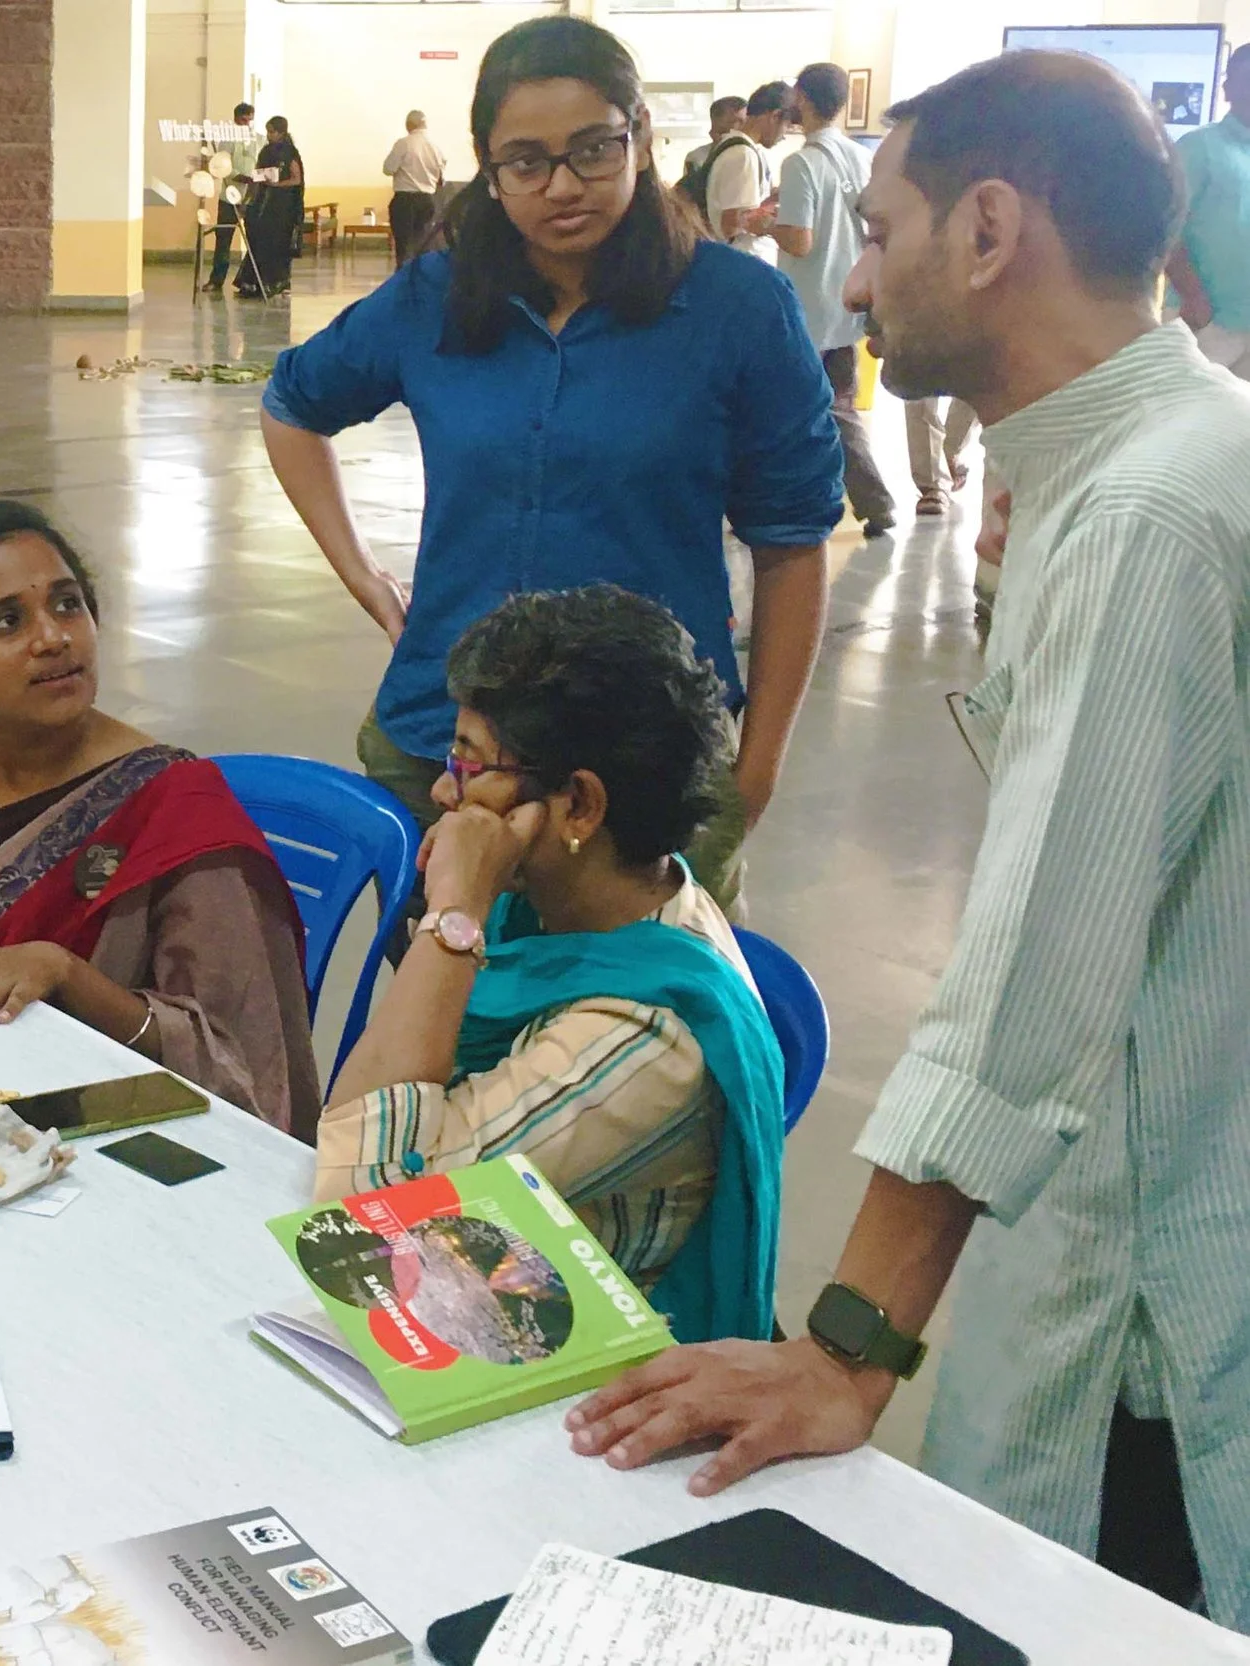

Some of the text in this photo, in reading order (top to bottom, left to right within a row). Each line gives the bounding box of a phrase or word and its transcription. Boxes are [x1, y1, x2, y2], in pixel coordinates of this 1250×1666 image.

[360, 1200, 414, 1256] BUSTLING
[363, 1274, 430, 1357] EXPENSIVE
[569, 1238, 647, 1329] TOKYO
[167, 1553, 267, 1652] HUMAN-ELEPHANT
[168, 1582, 223, 1633] CONFLICT
[196, 1558, 279, 1639] FOR MANAGING
[219, 1555, 296, 1631] FIELD MANUAL
